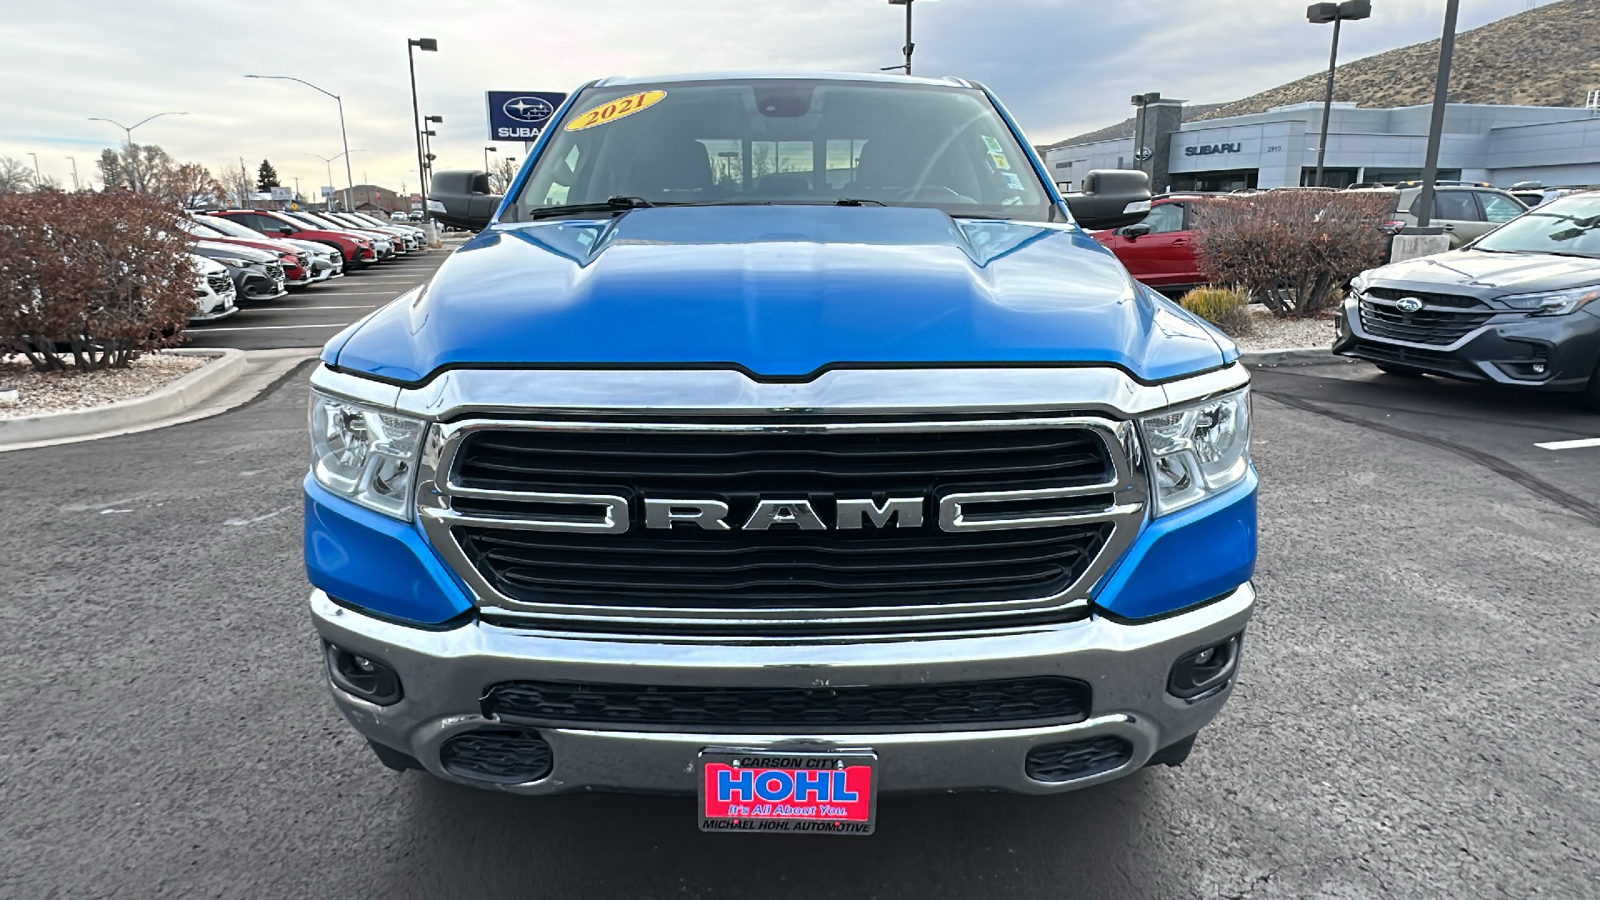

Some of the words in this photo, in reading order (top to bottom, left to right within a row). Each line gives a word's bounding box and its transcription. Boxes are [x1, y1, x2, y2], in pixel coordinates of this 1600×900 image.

[584, 94, 646, 127] 2021
[498, 127, 542, 138] SUBA
[1184, 142, 1241, 157] SUBARU
[644, 497, 925, 531] RAM
[741, 757, 803, 768] CARSON
[806, 758, 839, 769] CITY
[717, 769, 859, 803] HOHL
[728, 804, 750, 815] It's
[751, 804, 772, 816] All
[773, 804, 817, 816] About
[702, 819, 755, 830] MICHAEL
[758, 821, 791, 831] HOHL
[792, 821, 871, 833] AUTOMOTIVE
